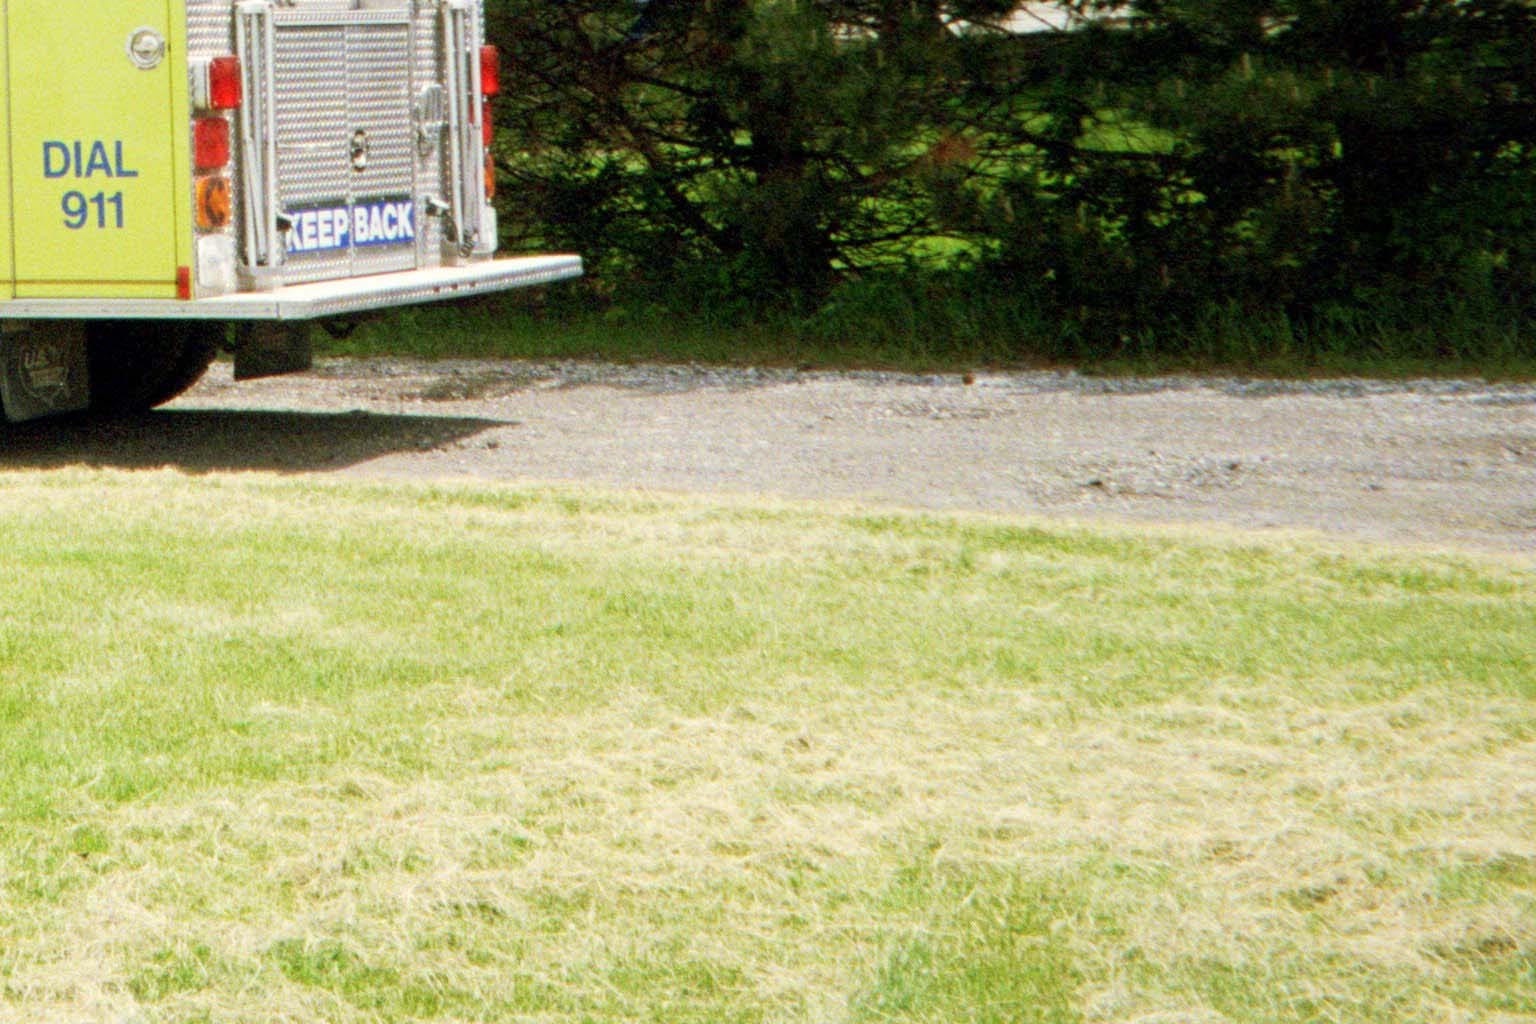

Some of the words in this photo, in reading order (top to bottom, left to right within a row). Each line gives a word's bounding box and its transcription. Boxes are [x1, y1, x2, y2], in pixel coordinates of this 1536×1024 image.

[42, 140, 139, 179] DIAL
[61, 191, 125, 230] 911
[285, 208, 349, 252] KEEP
[353, 202, 414, 242] BACK
